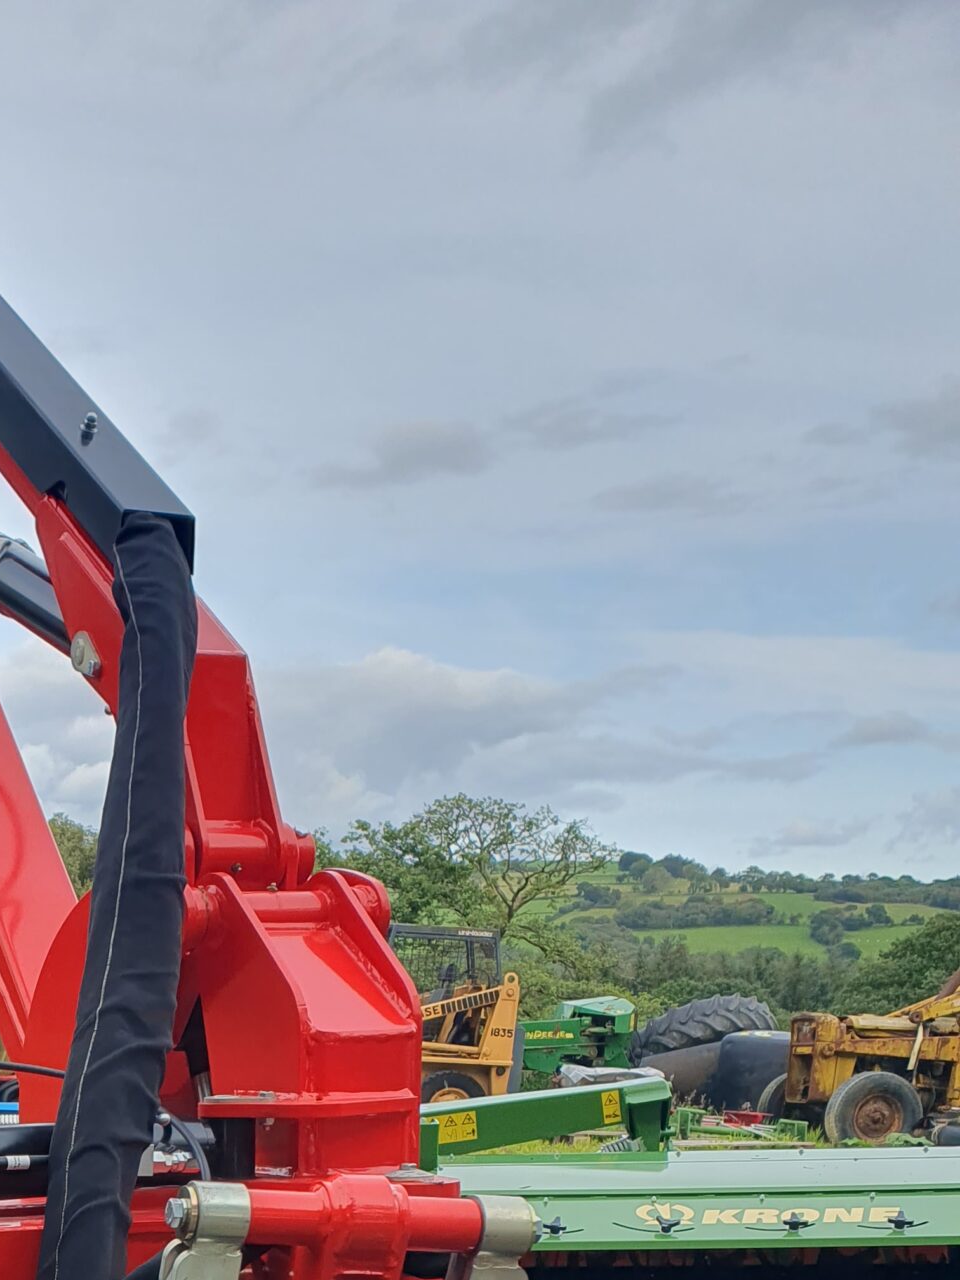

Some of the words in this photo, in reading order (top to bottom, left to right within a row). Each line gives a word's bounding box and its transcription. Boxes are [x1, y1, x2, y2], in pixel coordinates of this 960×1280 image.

[422, 1005, 440, 1017] SE
[490, 1027, 514, 1038] 1835
[701, 1207, 901, 1225] KRONE
